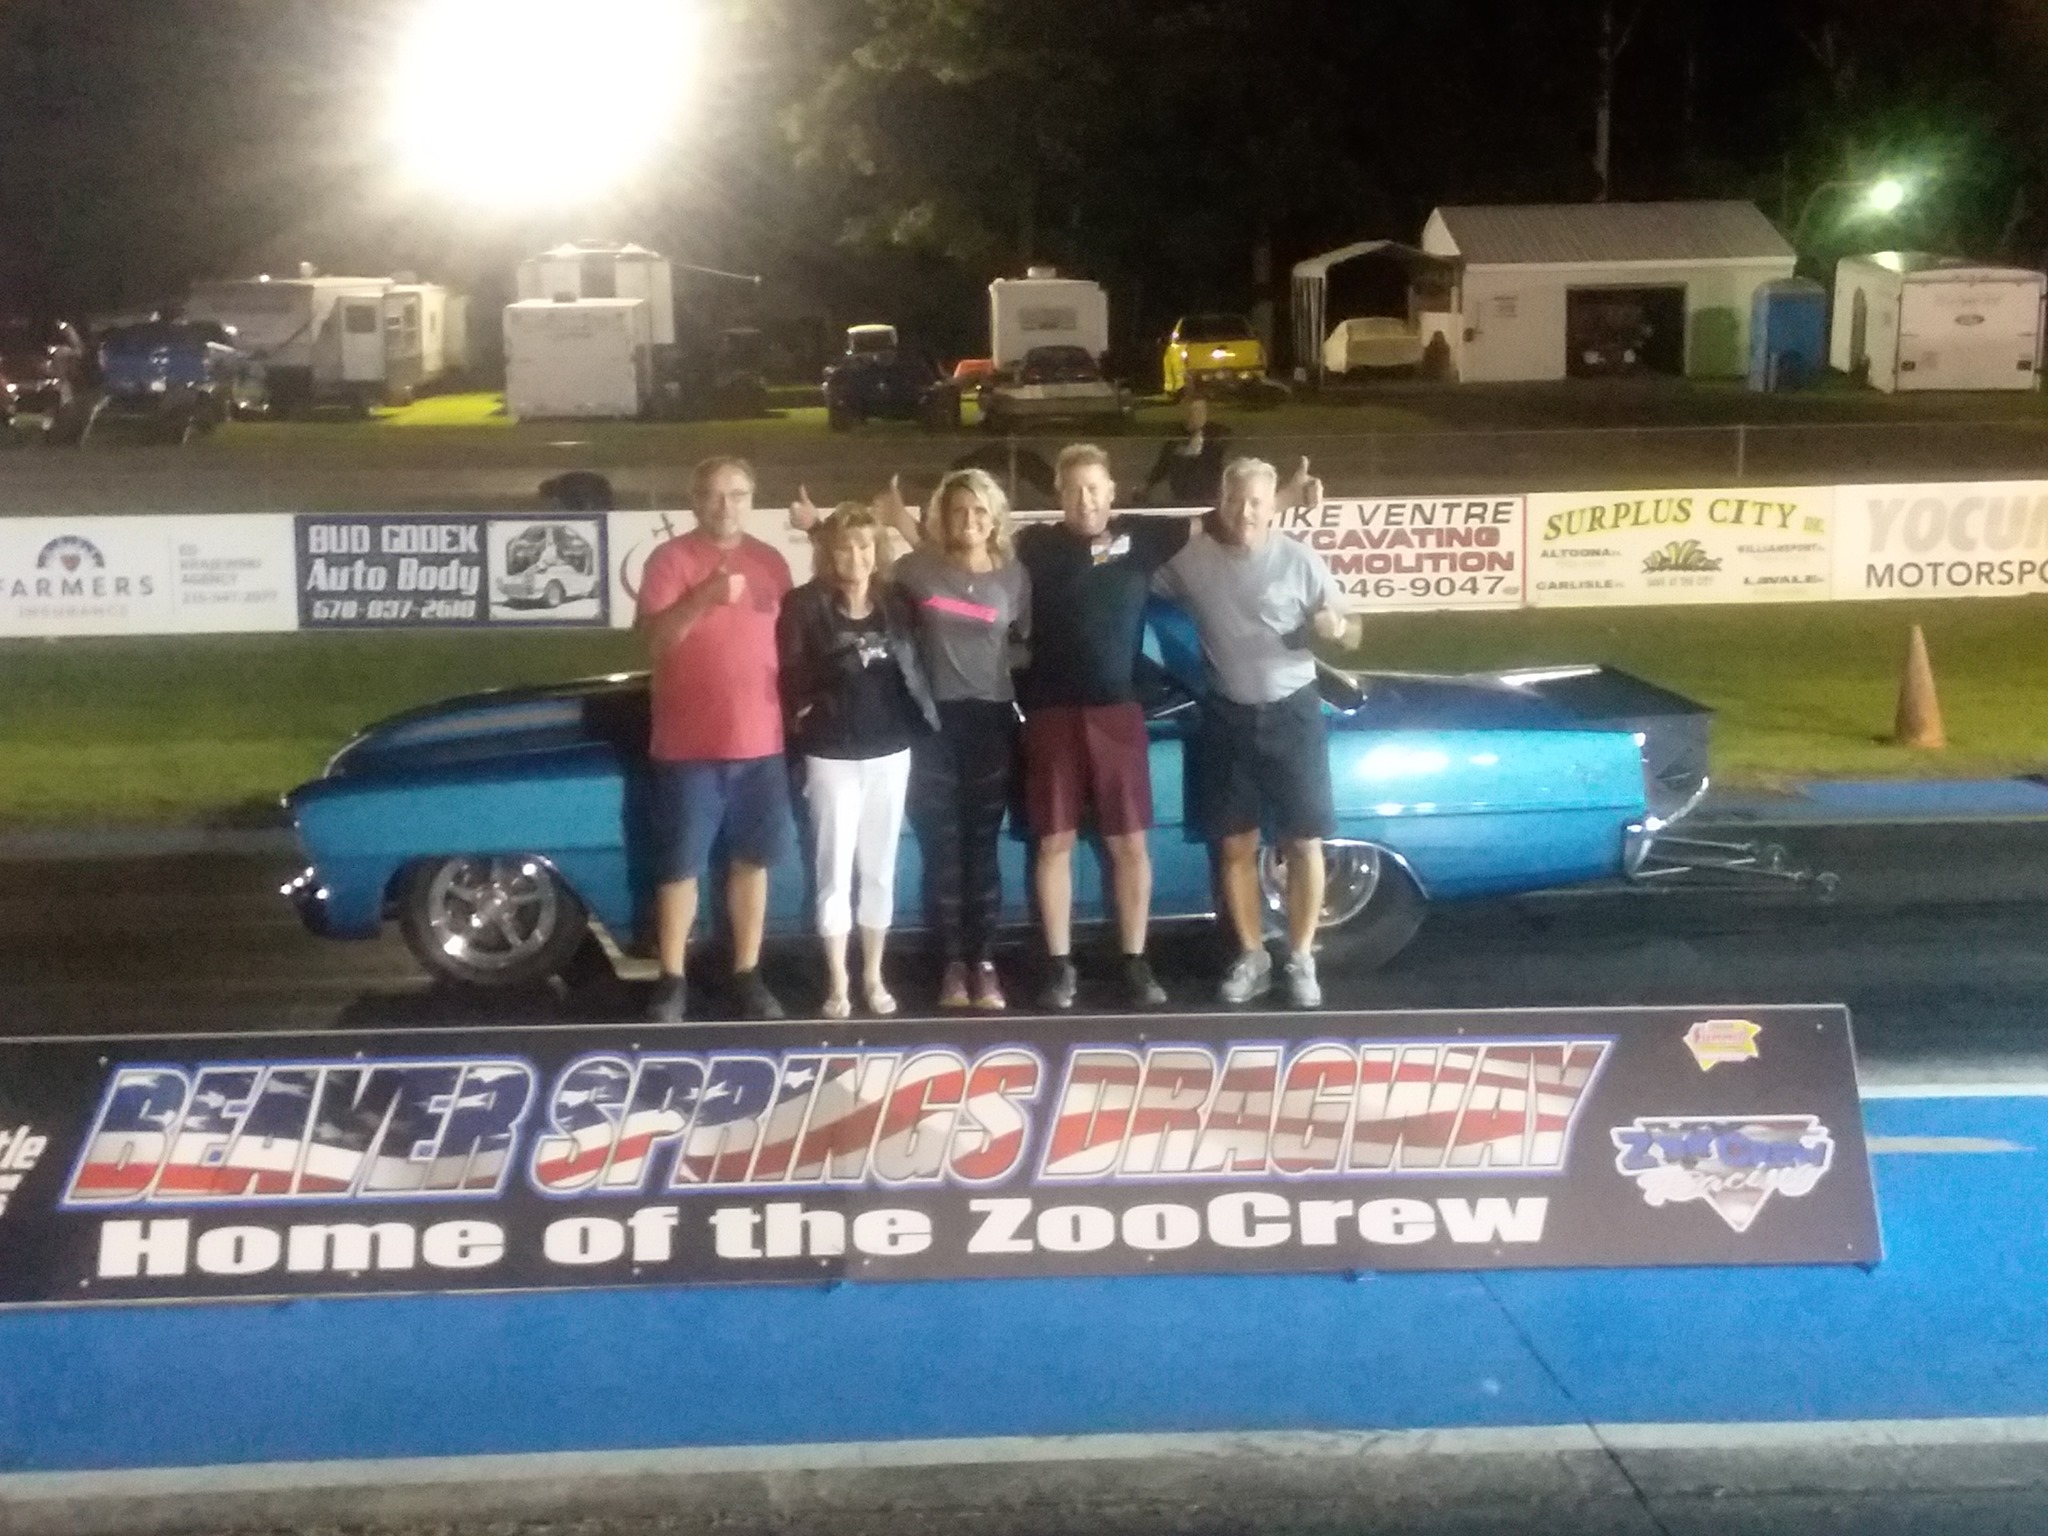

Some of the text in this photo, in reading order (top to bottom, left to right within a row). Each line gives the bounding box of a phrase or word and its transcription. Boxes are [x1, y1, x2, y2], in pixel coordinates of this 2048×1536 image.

[1268, 501, 1515, 528] IKE VENTRE
[1542, 497, 1694, 541] SURPLUS
[1708, 498, 1798, 529] CITY
[308, 524, 480, 554] BUD GODEK
[1283, 526, 1501, 551] XCAVATING
[1321, 551, 1515, 576] MOLITION
[1540, 547, 1611, 559] ALTOONA
[306, 557, 481, 596] Auto Body
[1535, 579, 1614, 591] CARLISLE
[64, 1038, 1617, 1207] BEAVER SPRINGS DRAGWAY
[97, 1191, 1549, 1279] Home of the ZooCrew
